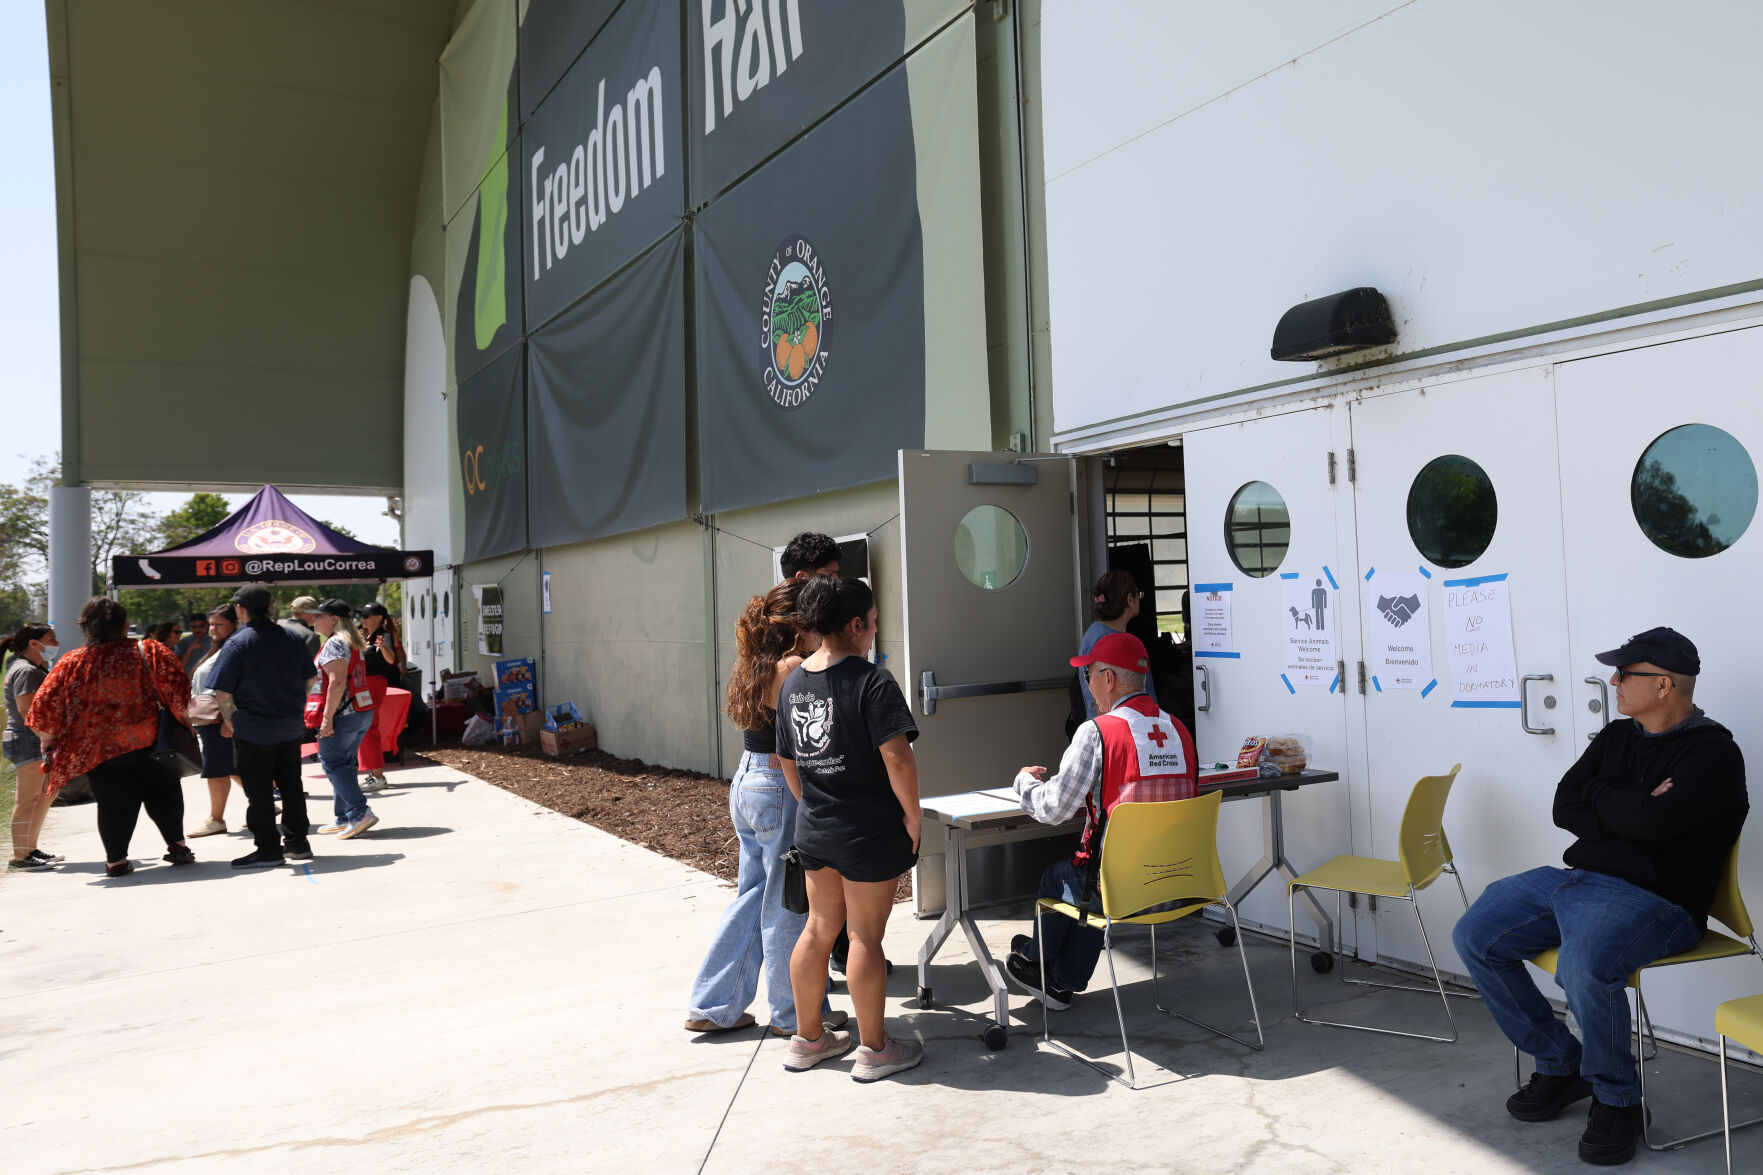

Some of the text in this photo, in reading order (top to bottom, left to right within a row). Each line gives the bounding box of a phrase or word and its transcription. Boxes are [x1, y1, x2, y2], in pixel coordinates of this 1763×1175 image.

[532, 66, 664, 281] Freedom
[761, 239, 832, 349] COUNTY OF ORANGE
[763, 350, 829, 407] CALIFORNIA
[245, 559, 376, 575] @RepLouCorrea
[1448, 589, 1496, 608] PLEASE
[1466, 615, 1484, 629] NO
[1289, 637, 1308, 645] Service
[1387, 644, 1414, 652] Welcome
[1453, 643, 1489, 656] MEDIA
[1385, 658, 1419, 666] Bienvenido
[1466, 664, 1478, 675] IN
[1459, 678, 1515, 693] DORMATORY
